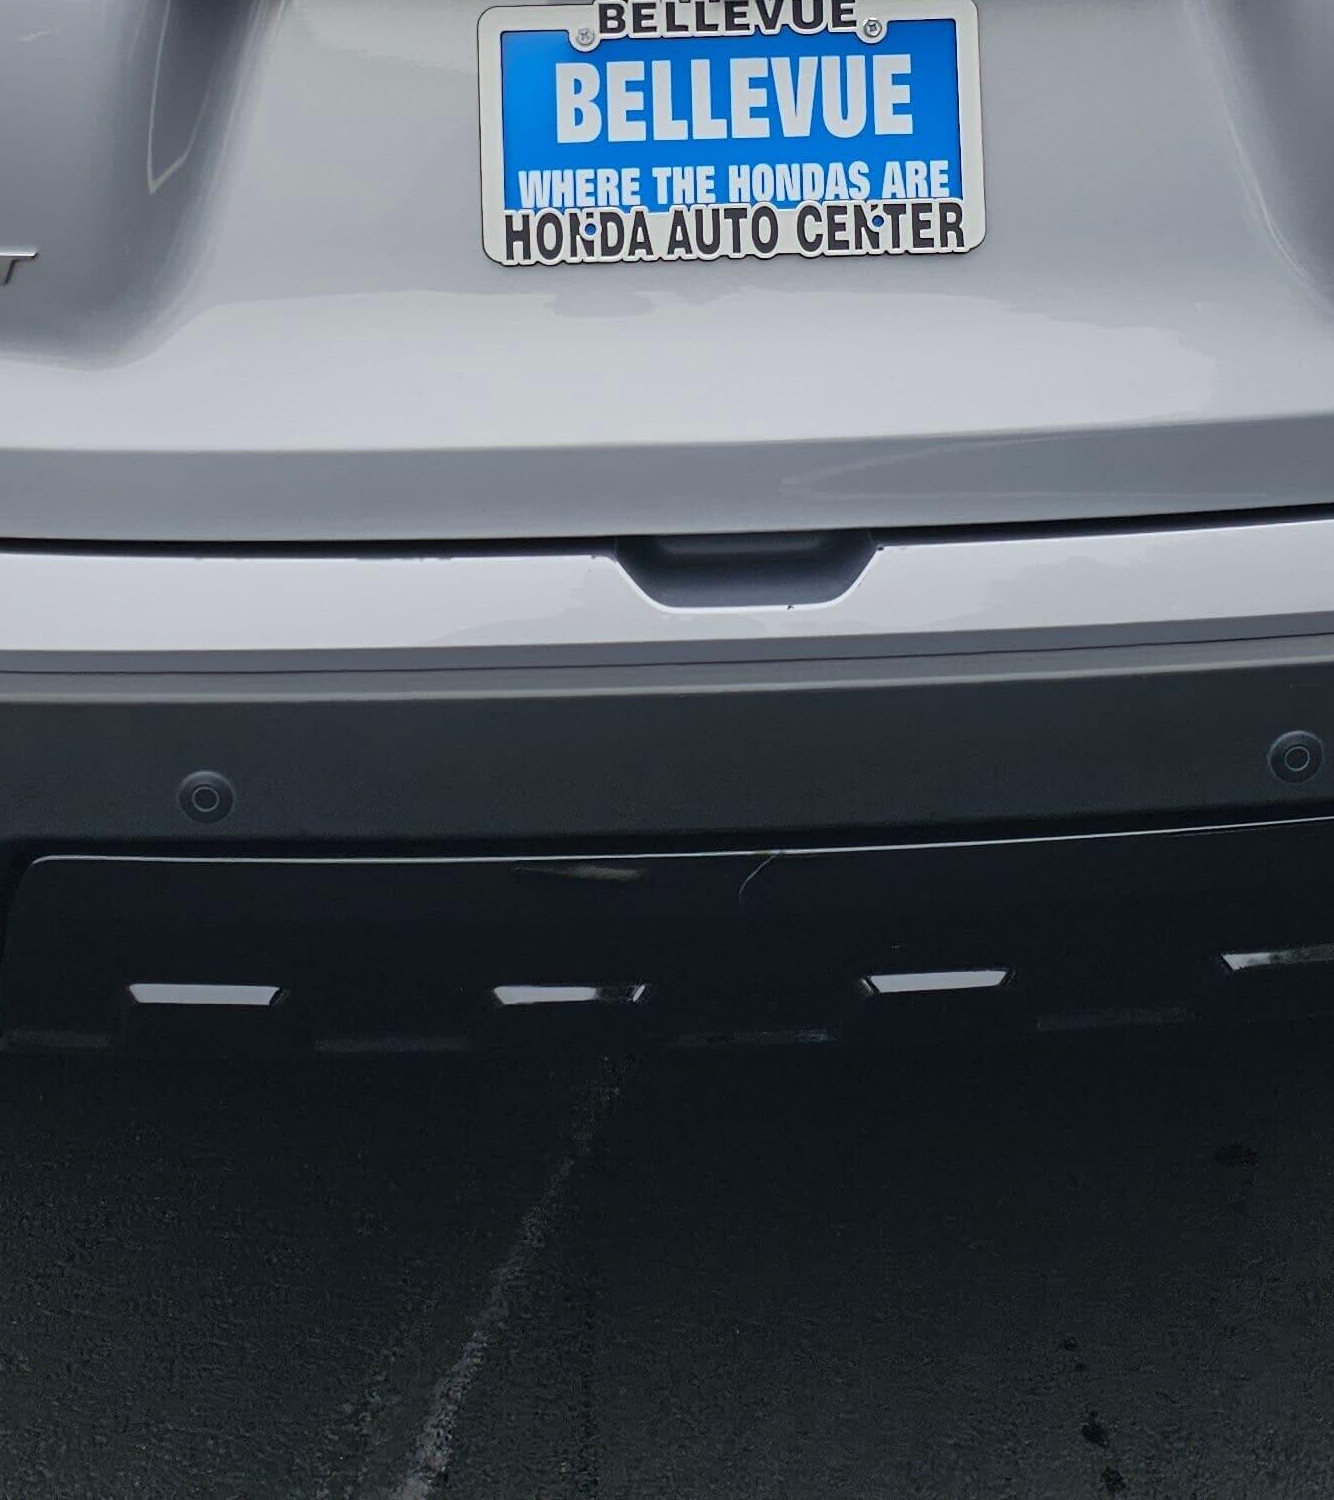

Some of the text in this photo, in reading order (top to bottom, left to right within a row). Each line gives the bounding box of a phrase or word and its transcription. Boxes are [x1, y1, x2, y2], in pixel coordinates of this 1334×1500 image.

[555, 54, 913, 143] BELLEVUE
[518, 160, 950, 208] WHERE THE HONDAS ARE
[504, 202, 965, 260] HONDA AUTO CENTER
